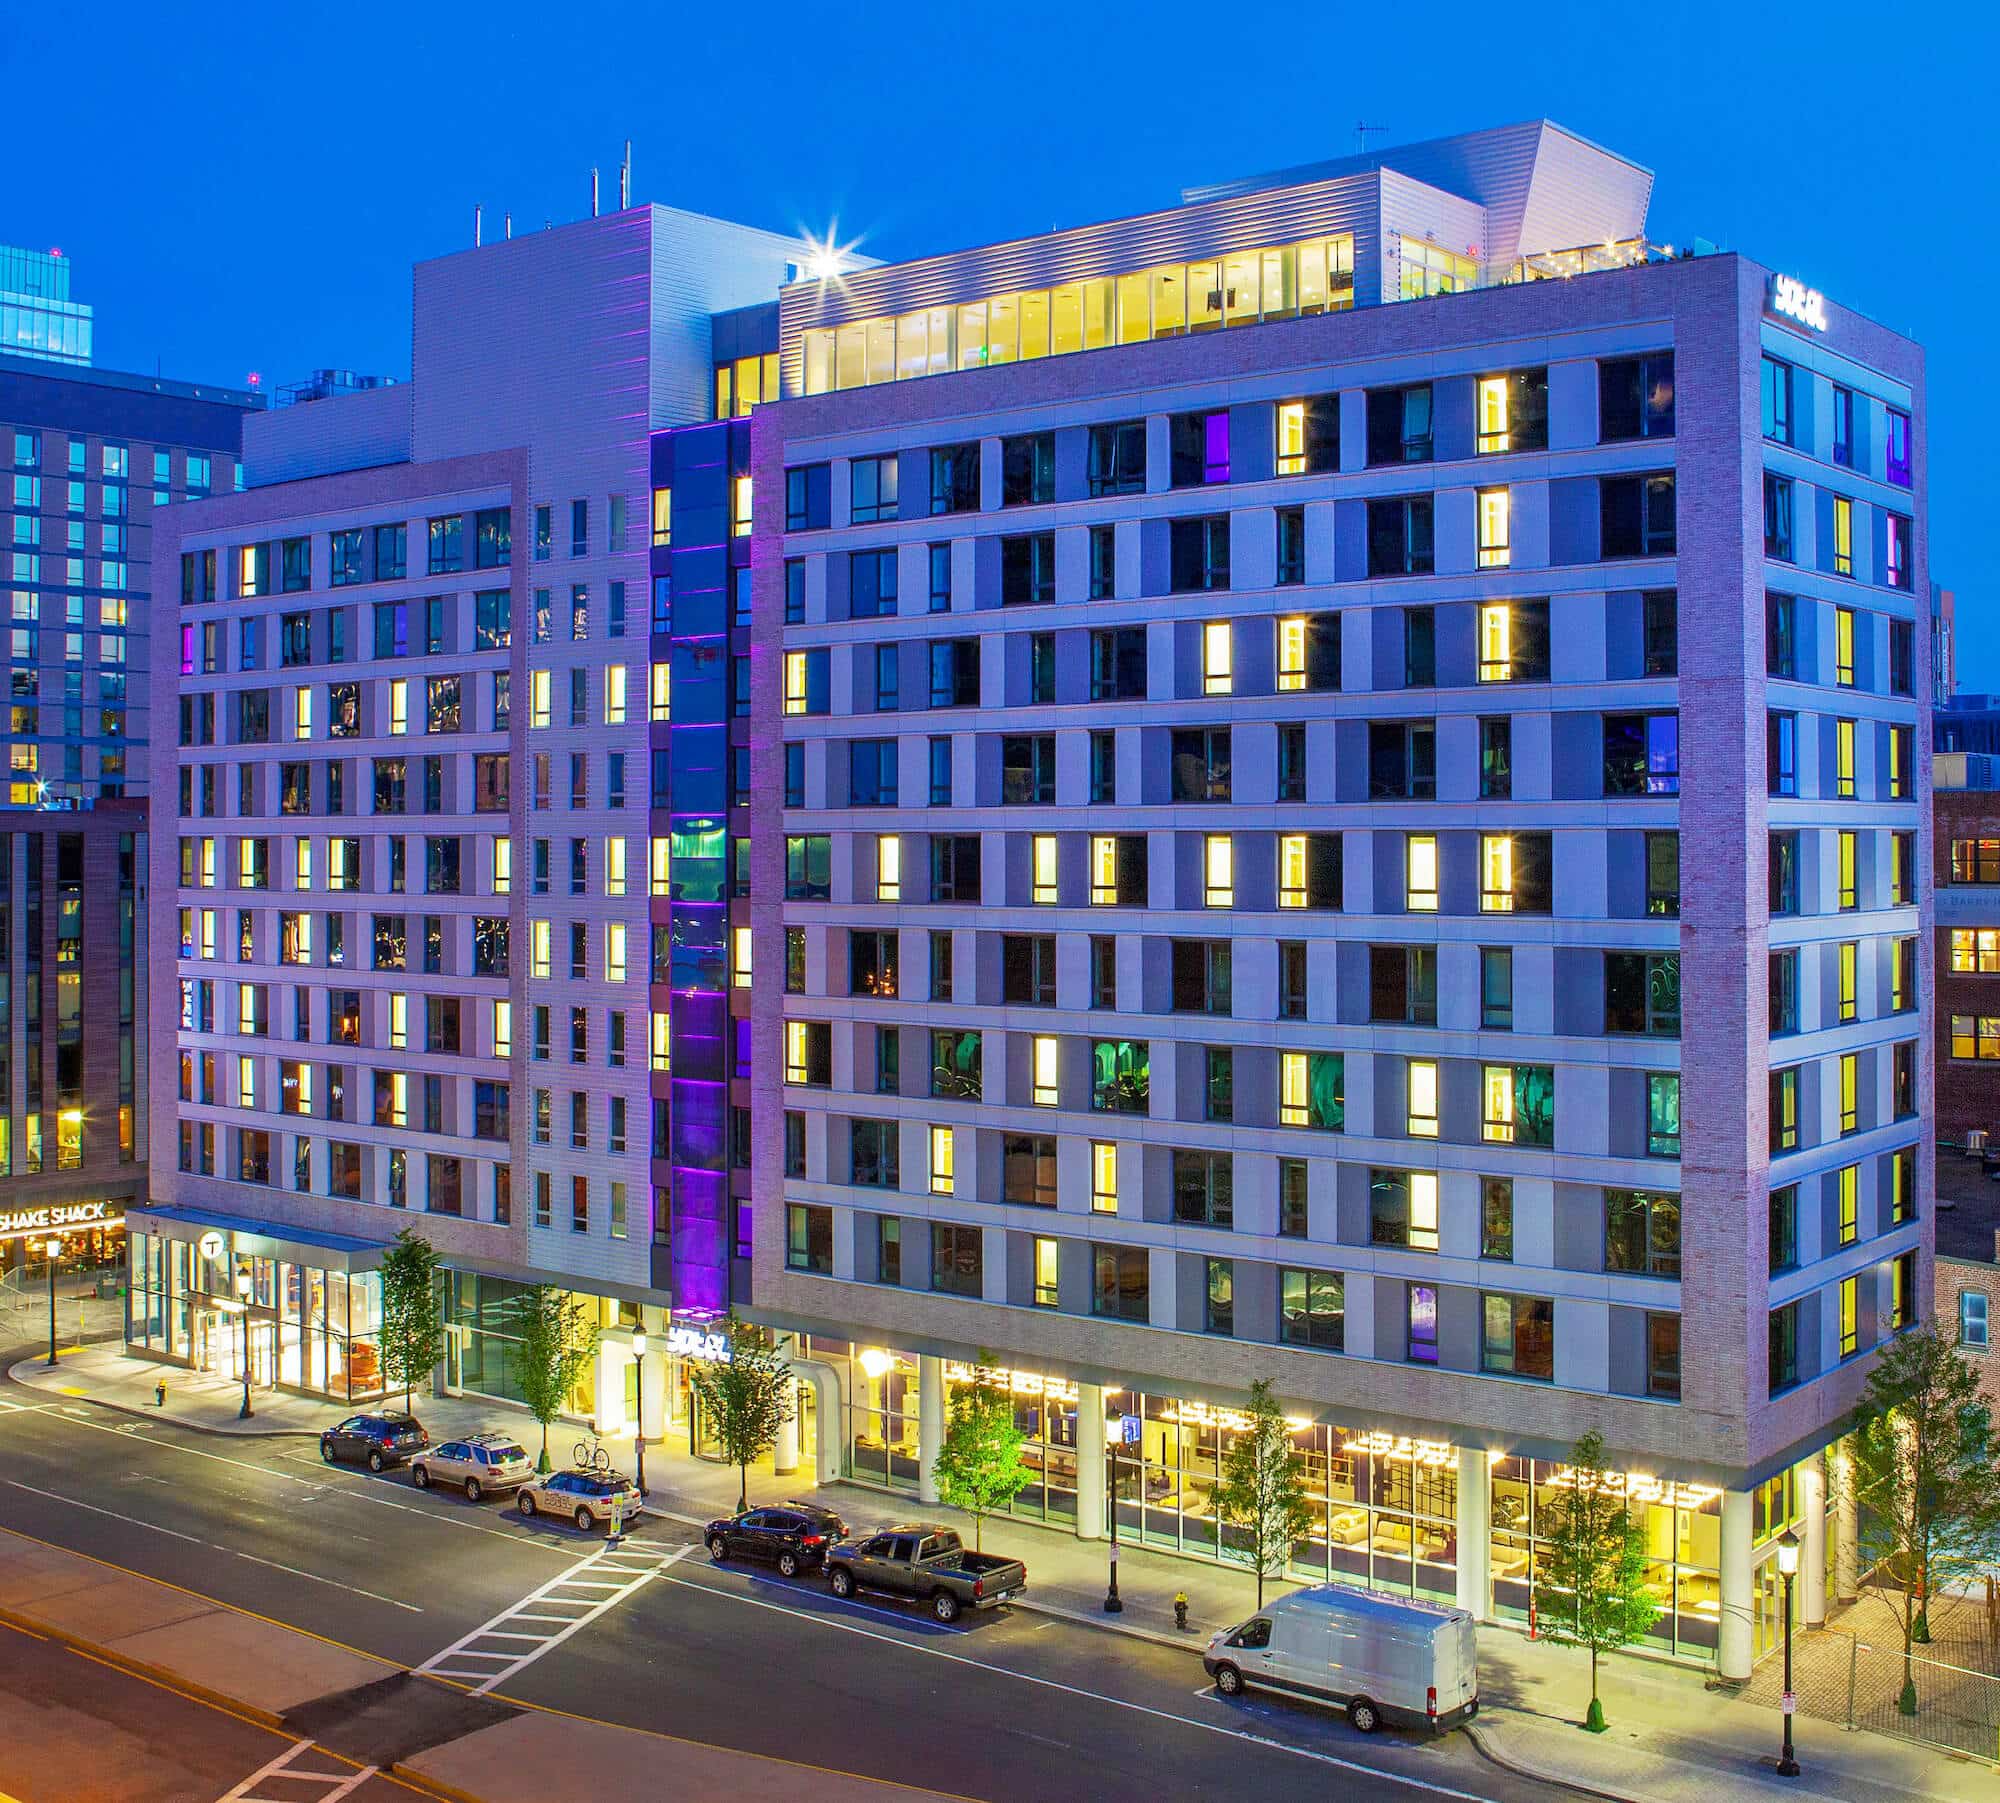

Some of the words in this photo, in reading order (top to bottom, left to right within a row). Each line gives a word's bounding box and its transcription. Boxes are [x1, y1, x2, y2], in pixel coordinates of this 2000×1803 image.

[0, 1209, 49, 1231] SHAKE
[50, 1202, 104, 1224] SHACK
[205, 1240, 220, 1256] T
